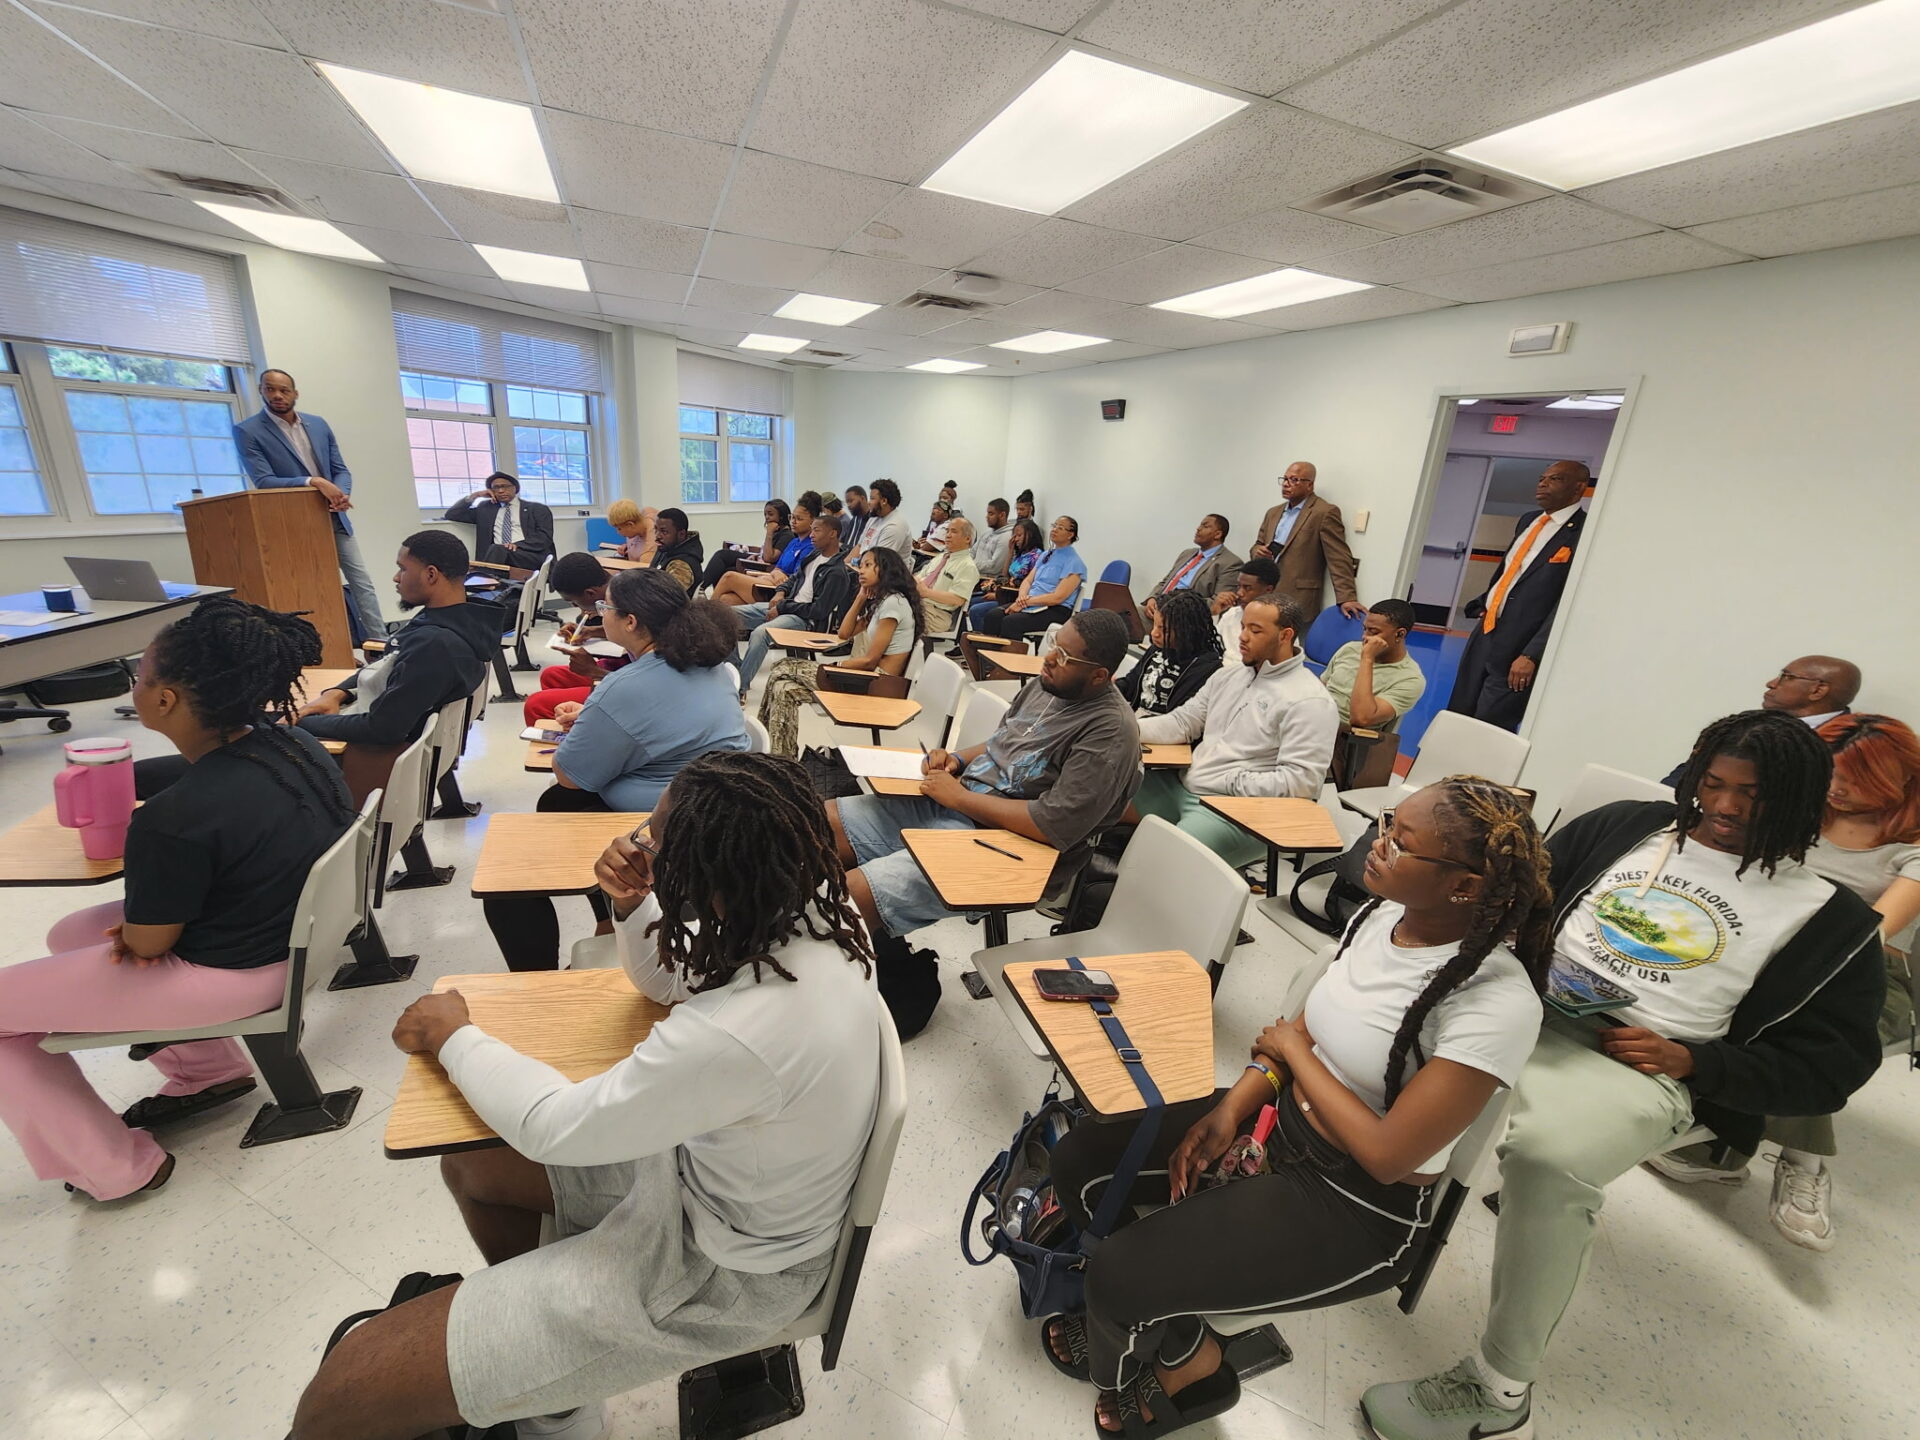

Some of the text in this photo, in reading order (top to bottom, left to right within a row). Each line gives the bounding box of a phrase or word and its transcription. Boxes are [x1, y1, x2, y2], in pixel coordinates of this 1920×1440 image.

[1693, 886, 1743, 929] FLORIDA
[1589, 945, 1632, 973] BEACH
[1637, 968, 1671, 984] USA
